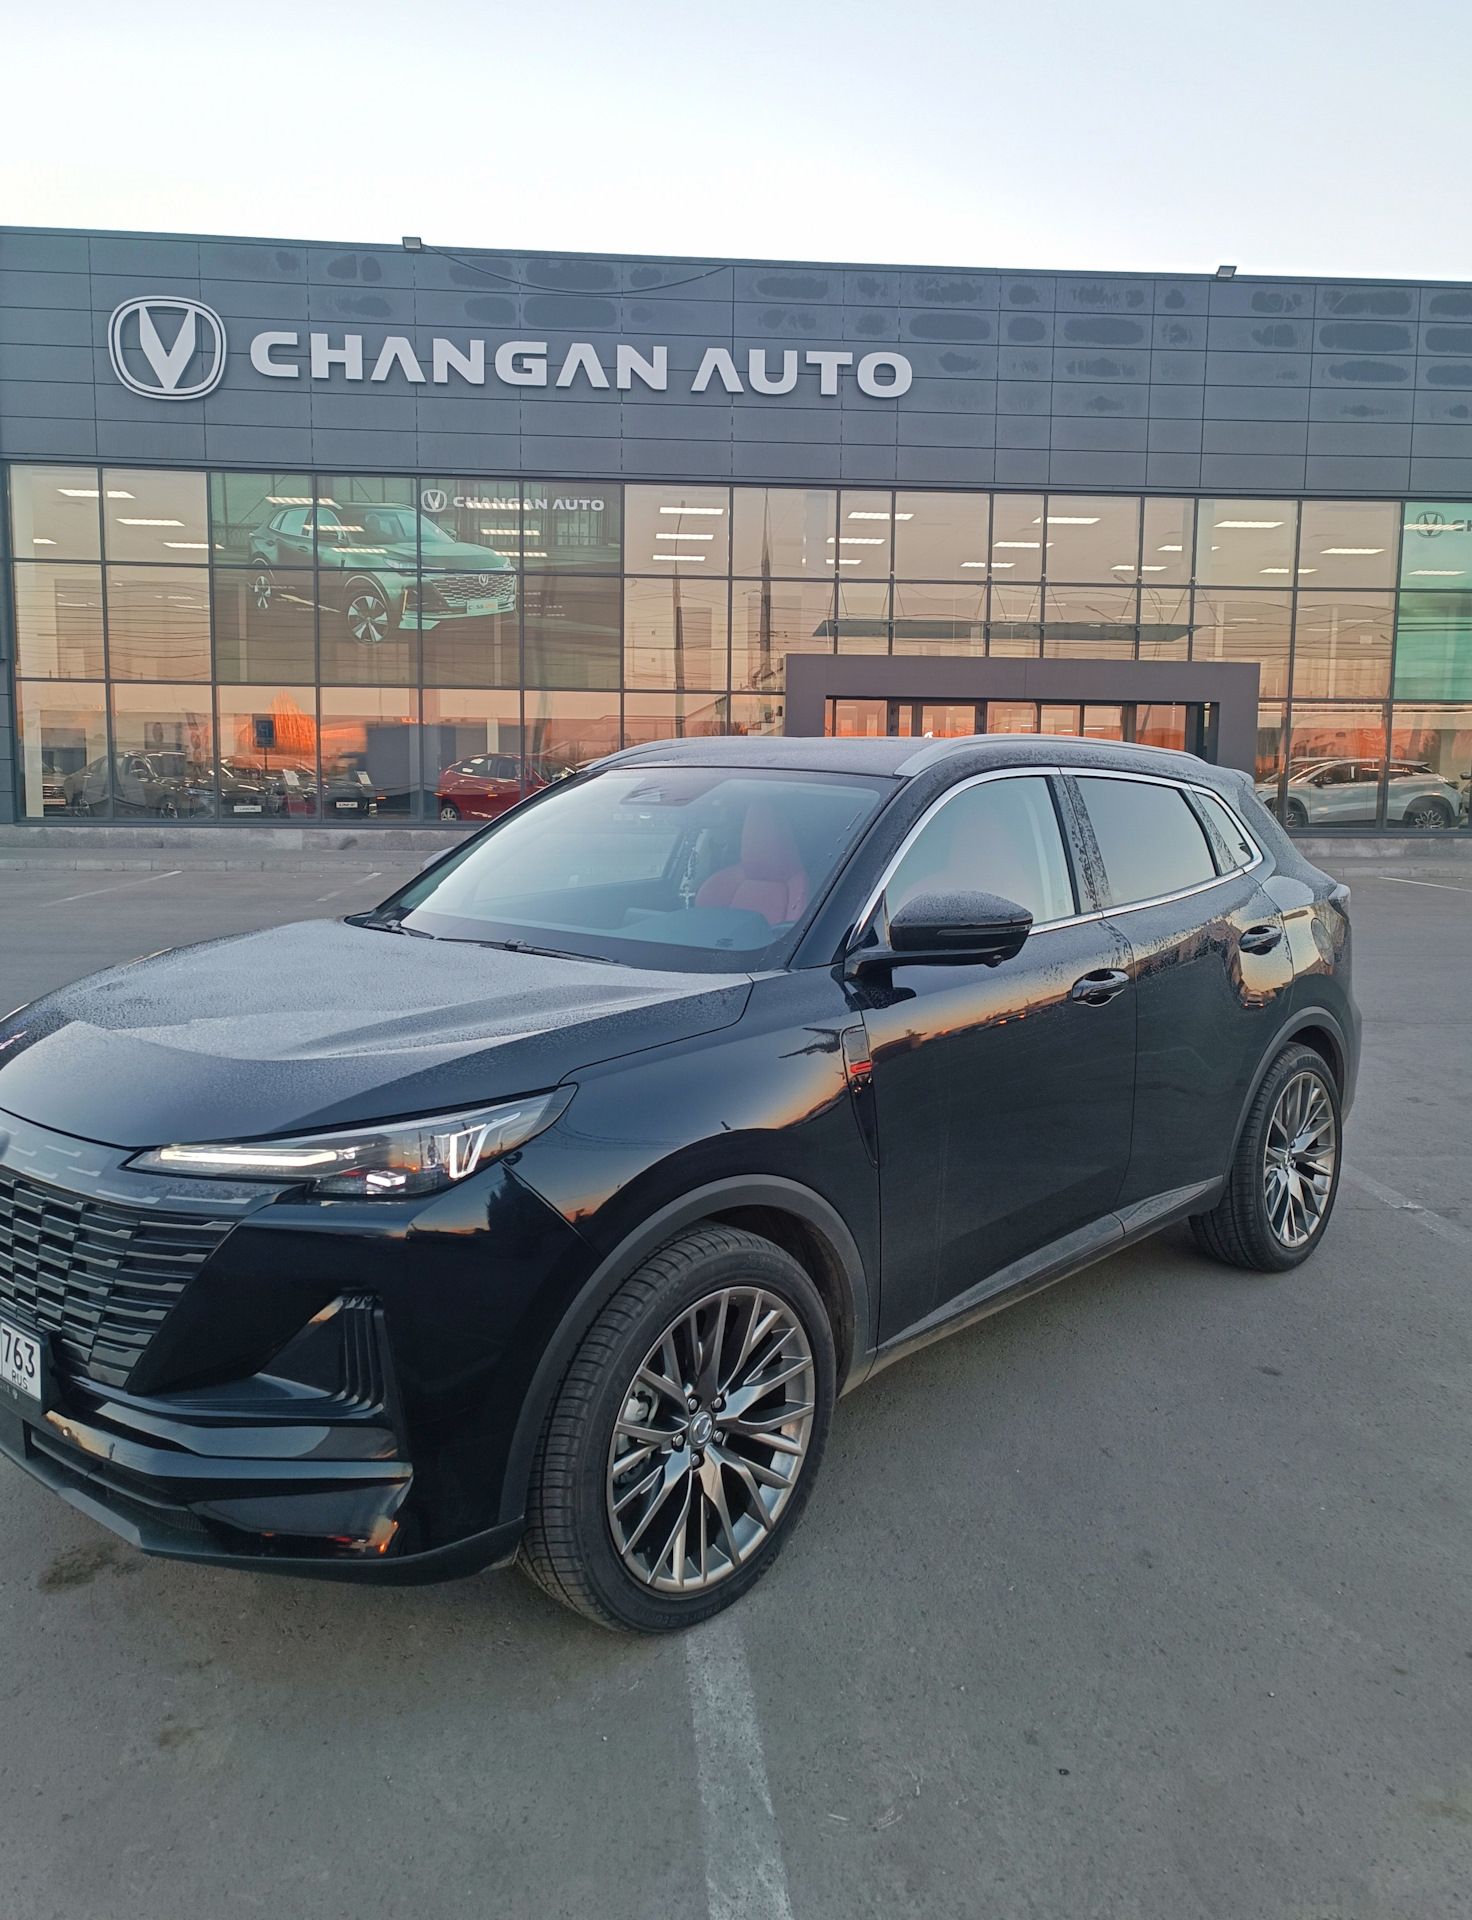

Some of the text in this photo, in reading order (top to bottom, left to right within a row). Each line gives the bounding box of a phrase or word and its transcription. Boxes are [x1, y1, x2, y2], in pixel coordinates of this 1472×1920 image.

[250, 331, 668, 390] CHANGAN
[690, 347, 913, 398] AUTO
[552, 499, 605, 511] AUTO
[2, 1328, 35, 1378] 763
[11, 1369, 28, 1390] RUS
